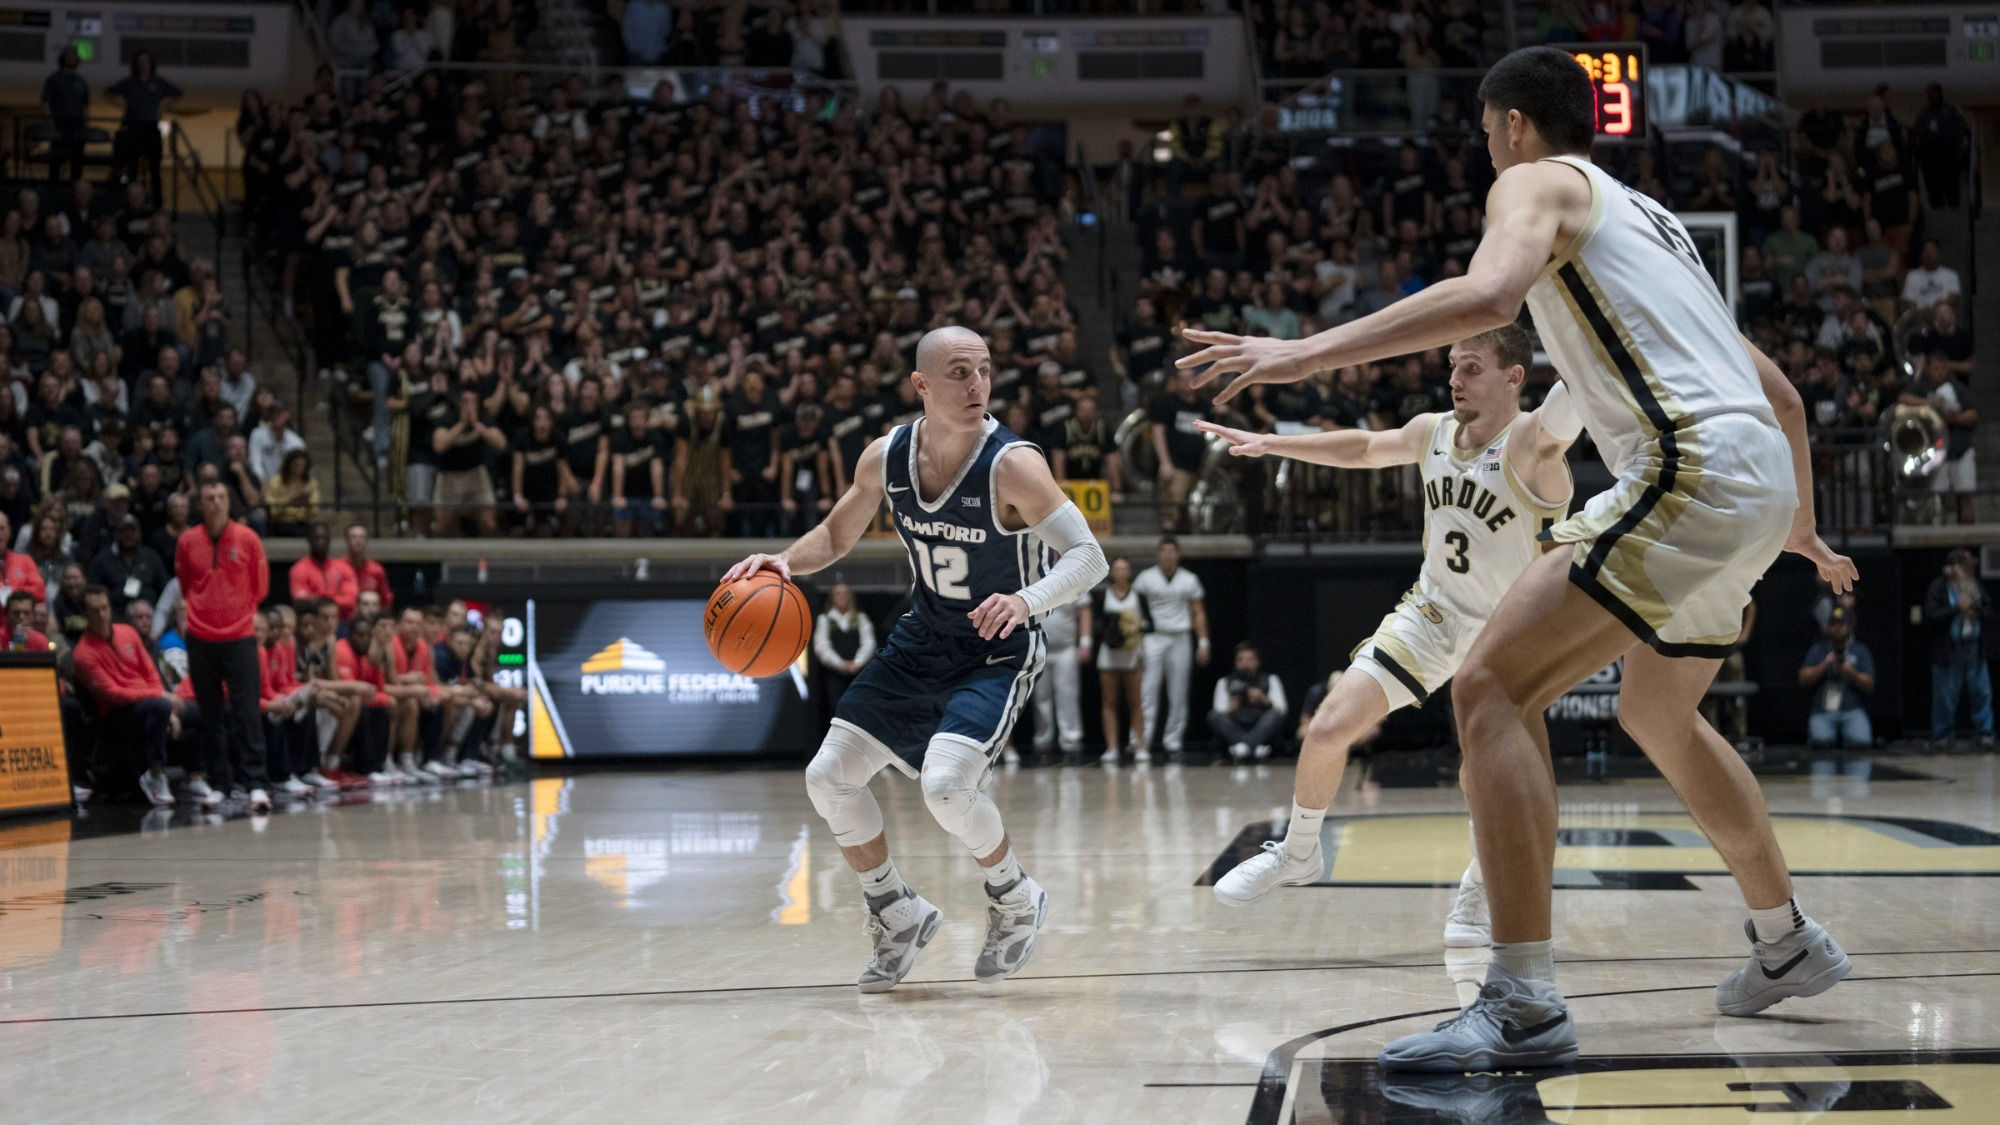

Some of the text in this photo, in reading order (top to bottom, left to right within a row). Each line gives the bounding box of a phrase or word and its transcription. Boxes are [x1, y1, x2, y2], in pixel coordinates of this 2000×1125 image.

[1593, 82, 1632, 134] 3
[1628, 198, 1700, 266] 15
[1426, 475, 1518, 533] URDUE
[912, 538, 972, 601] 12
[1444, 531, 1470, 574] 3
[581, 673, 760, 695] PURDUE FEDERAL
[9, 746, 58, 773] FEDERAL
